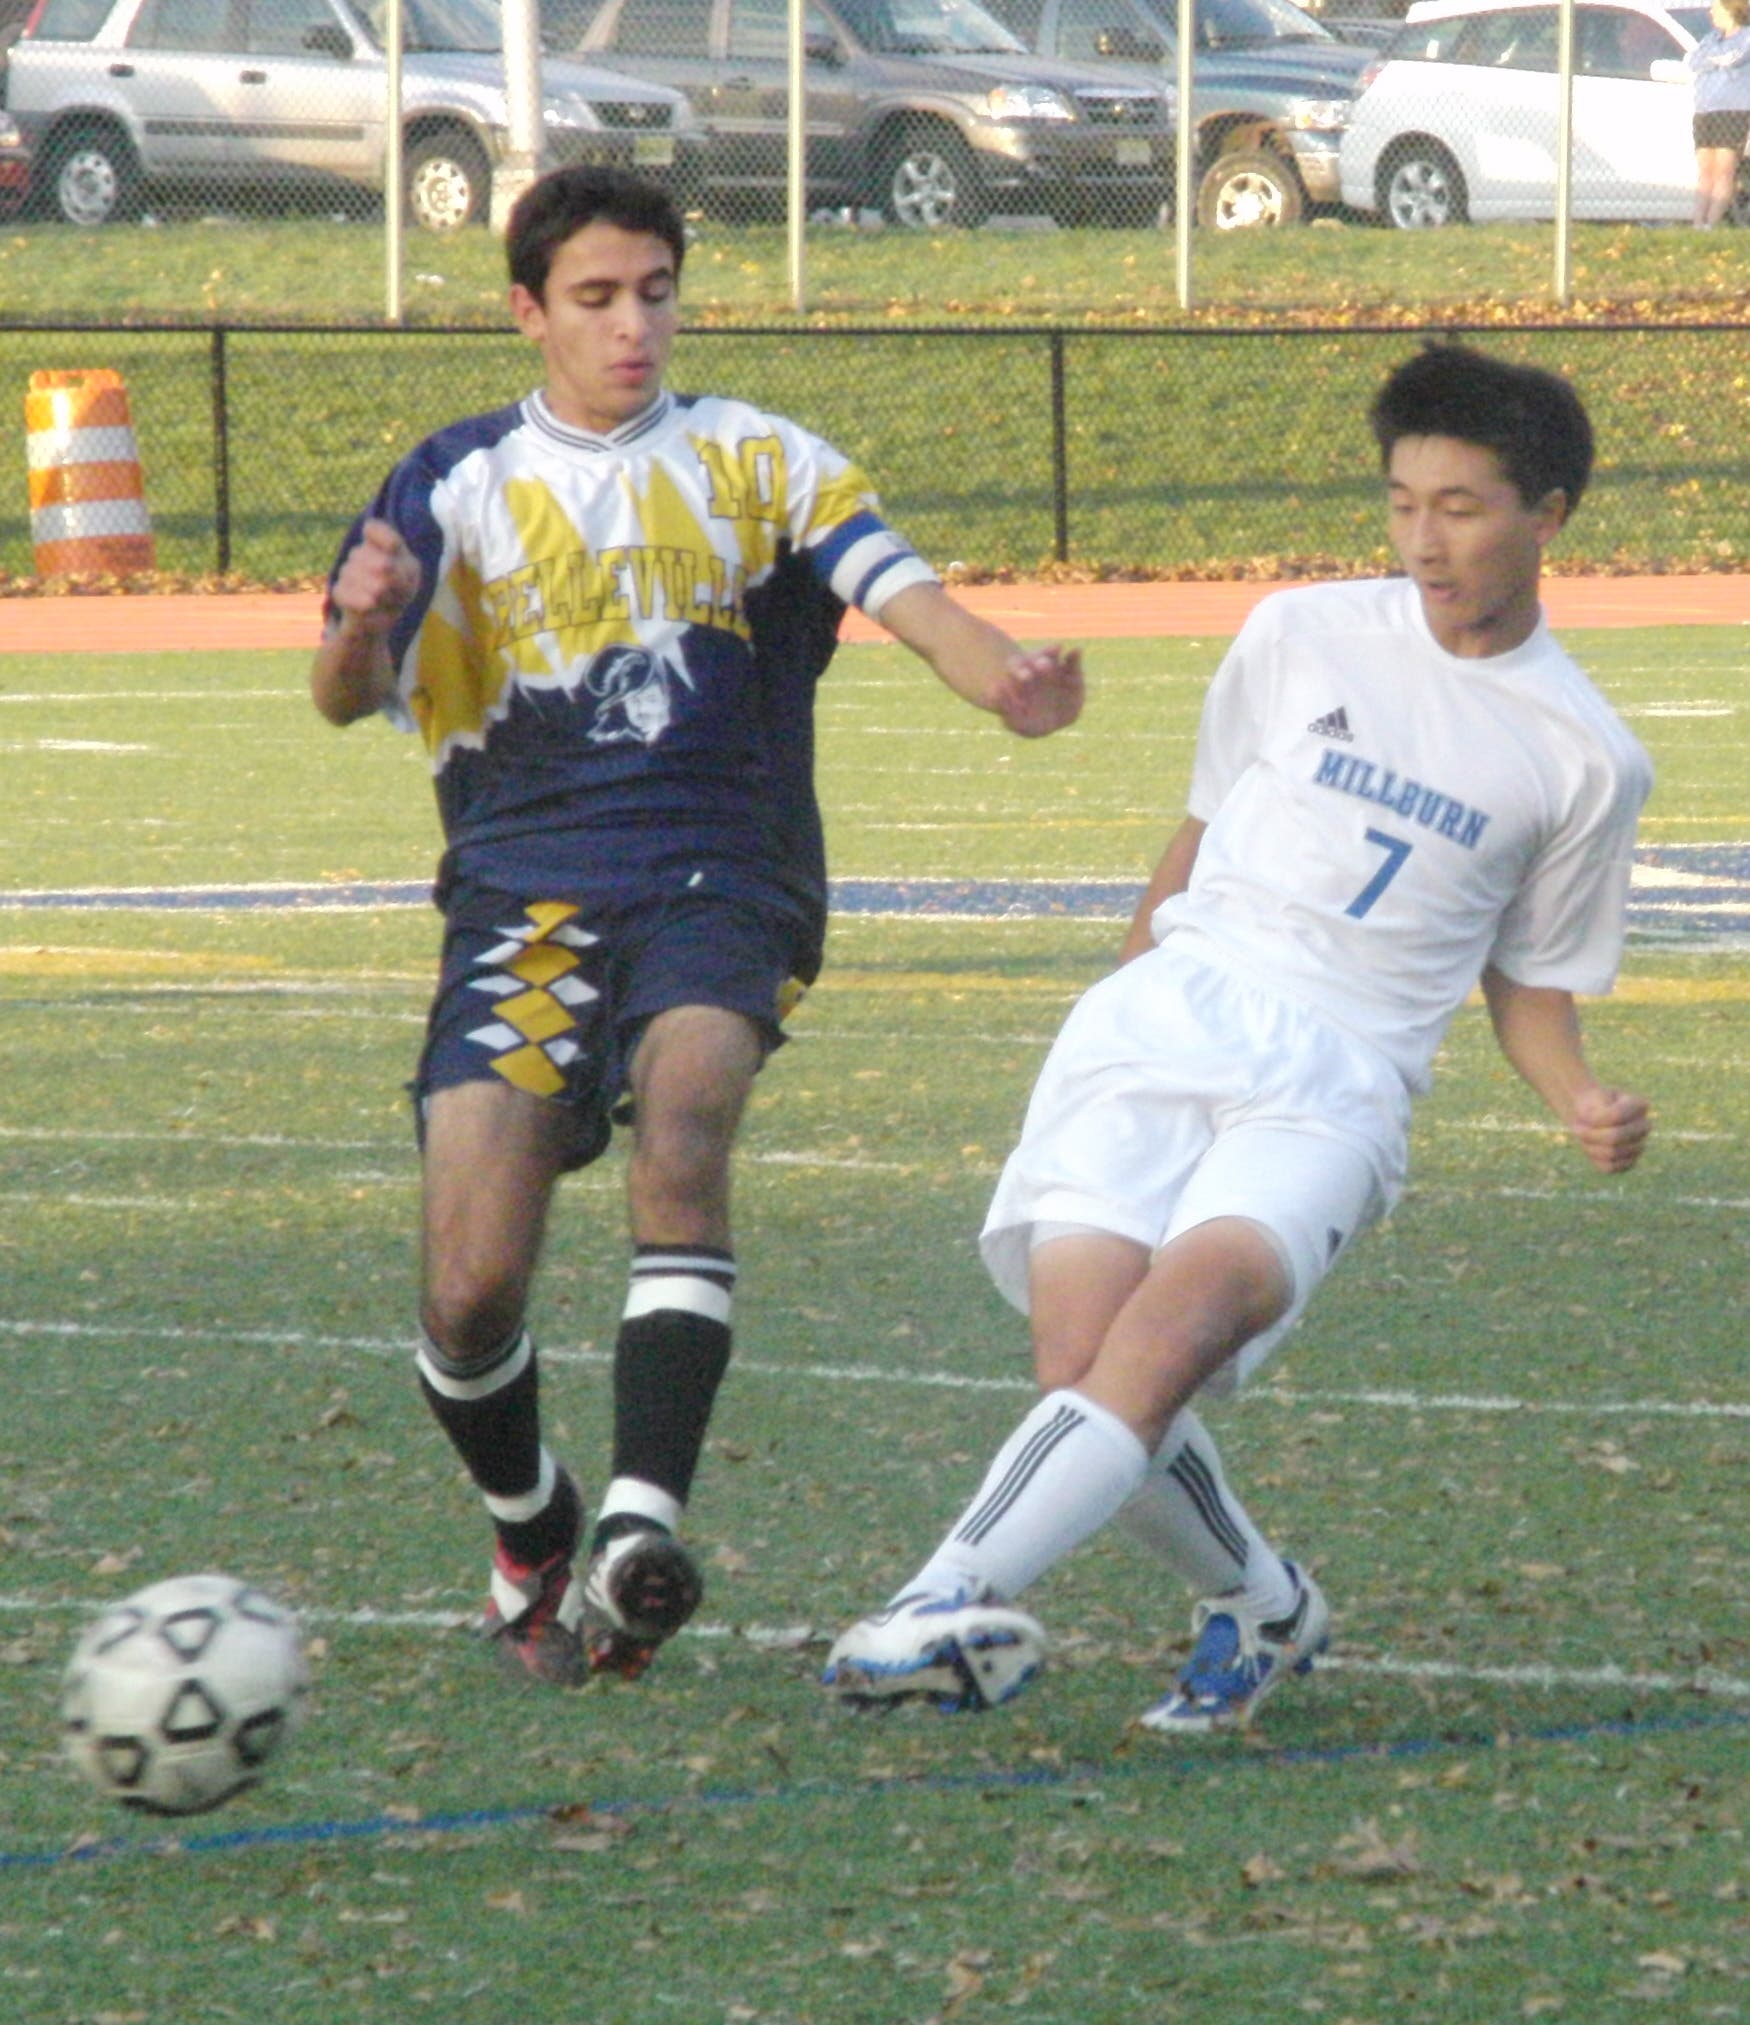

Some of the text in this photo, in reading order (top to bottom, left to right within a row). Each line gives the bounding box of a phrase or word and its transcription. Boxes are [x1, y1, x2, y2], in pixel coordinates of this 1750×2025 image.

[698, 437, 787, 520] 10
[1314, 749, 1489, 849] MILLBURN
[1345, 827, 1413, 919] 7
